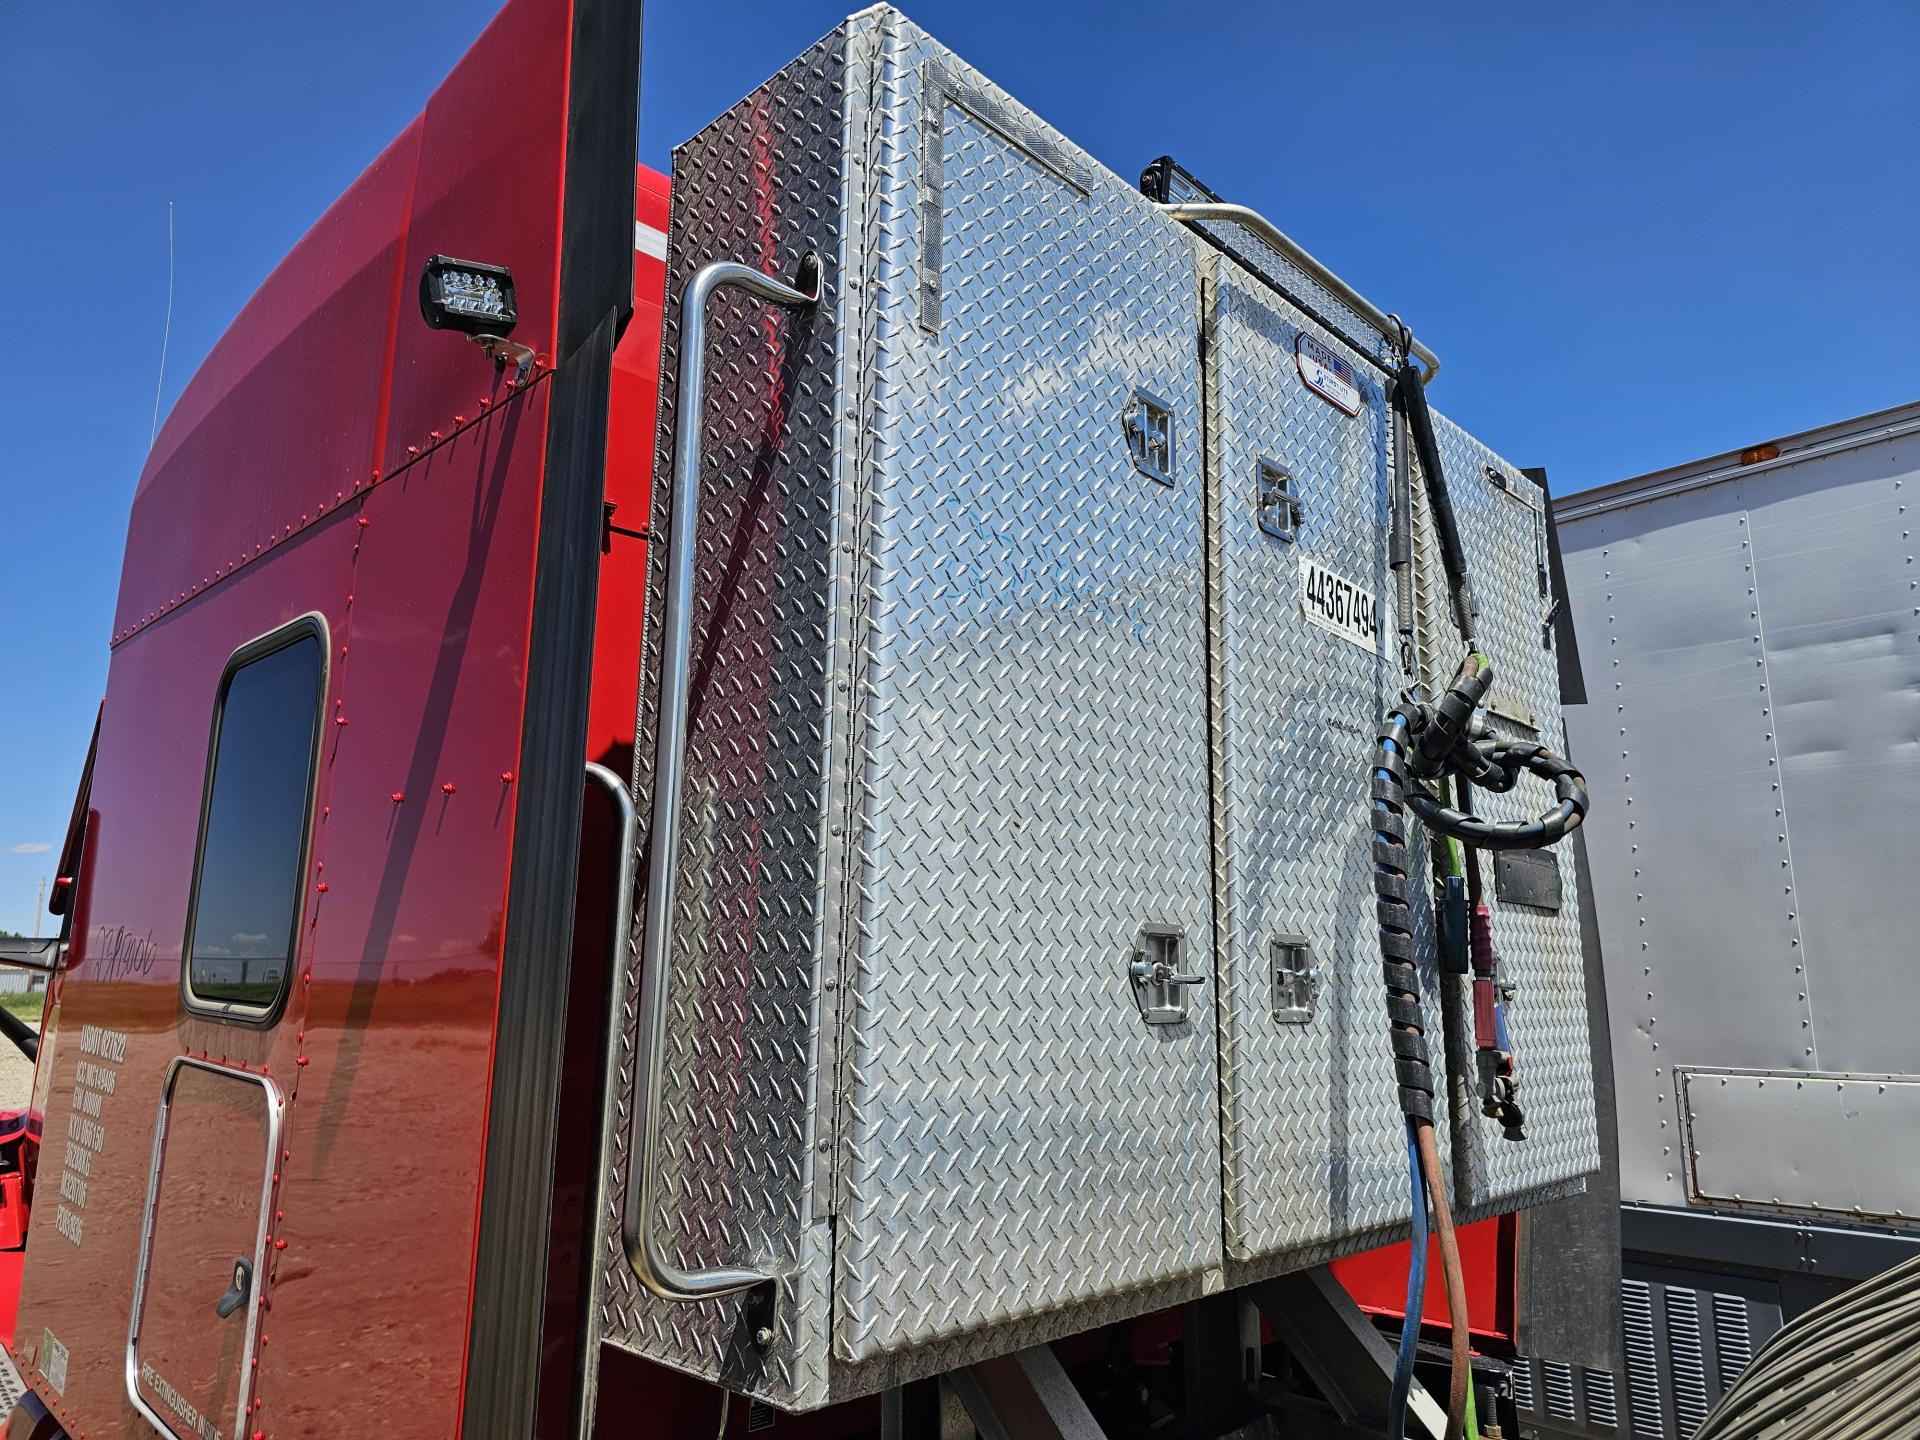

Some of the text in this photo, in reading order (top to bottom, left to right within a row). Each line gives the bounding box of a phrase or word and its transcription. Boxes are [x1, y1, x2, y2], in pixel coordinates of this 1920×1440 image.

[1307, 340, 1332, 364] MADE
[1307, 565, 1378, 642] 44367494
[80, 1024, 103, 1056] USDOT
[141, 1361, 155, 1387] FIRE
[154, 1374, 197, 1430] EXTINGUISHER
